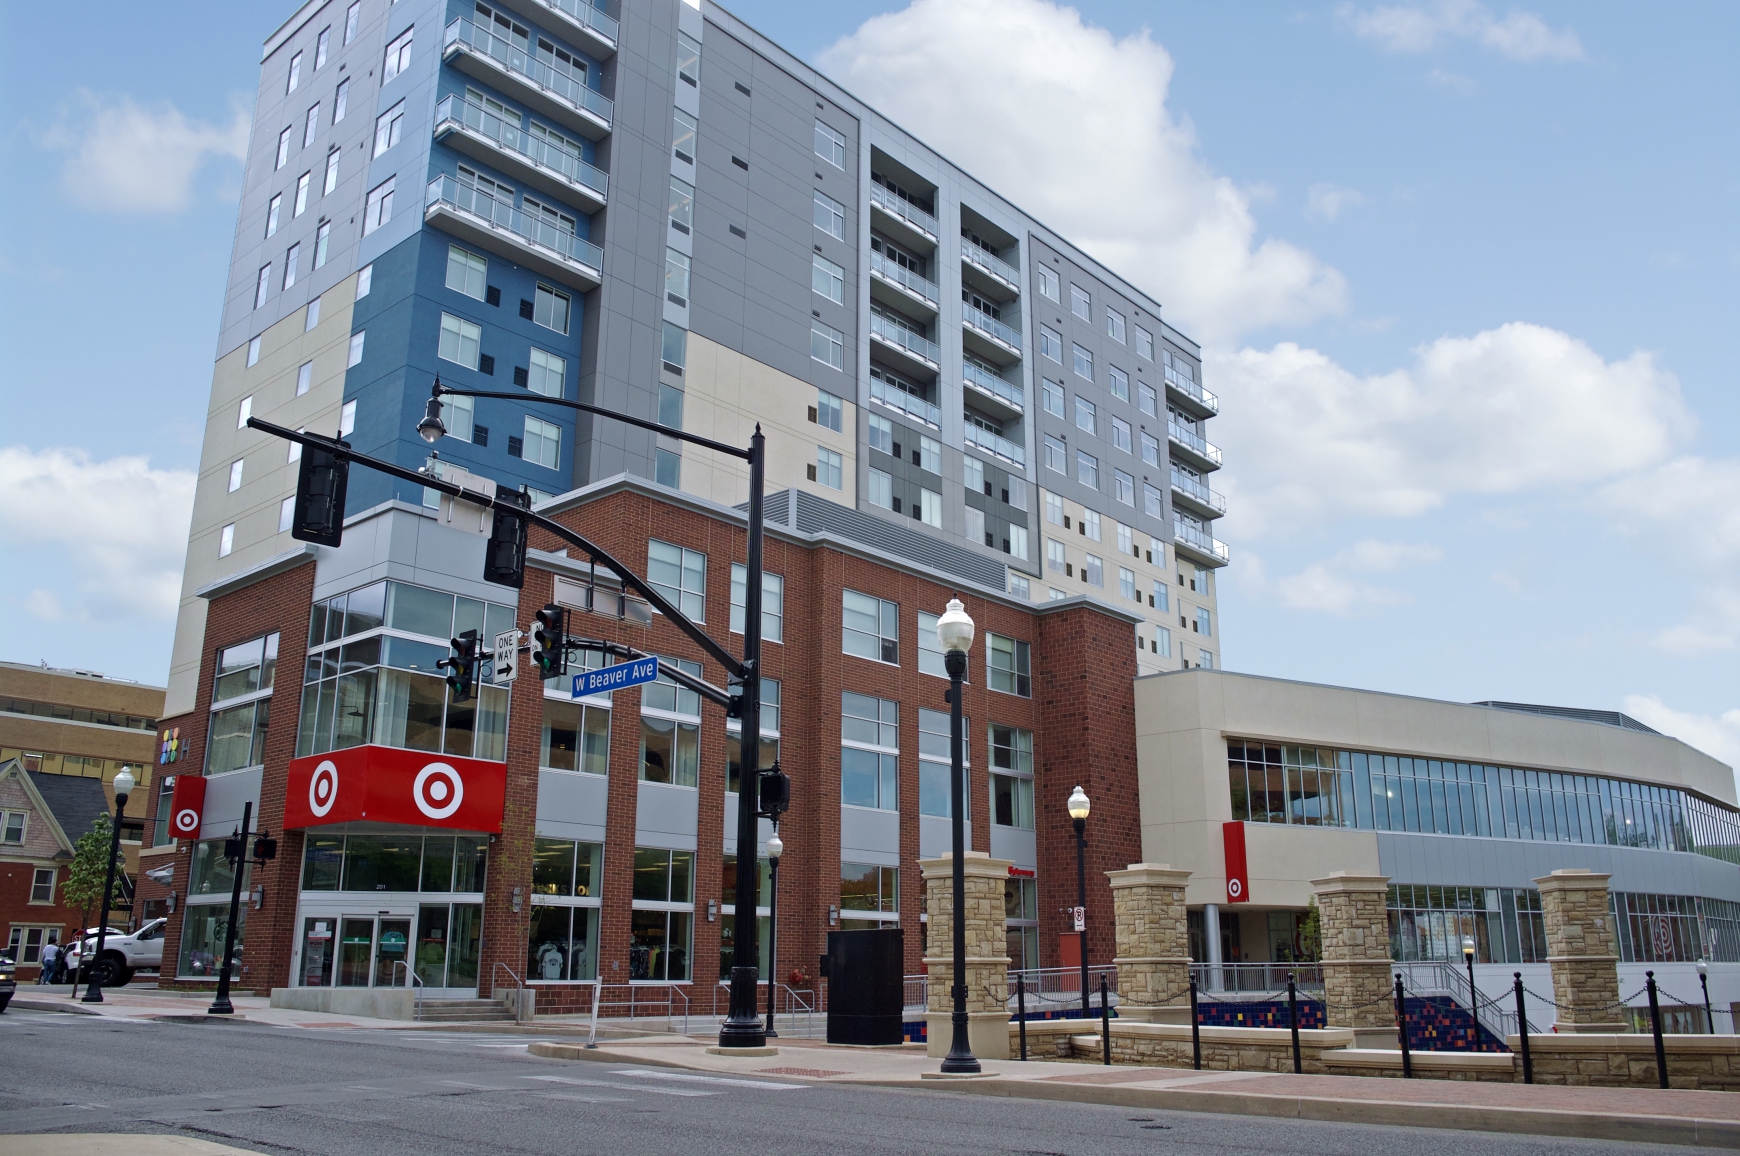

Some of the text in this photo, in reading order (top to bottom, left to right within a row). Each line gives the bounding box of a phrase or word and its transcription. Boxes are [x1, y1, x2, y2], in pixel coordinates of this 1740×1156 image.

[499, 635, 513, 649] ONE
[498, 649, 513, 662] WAY
[575, 663, 653, 692] W Beaver Ave
